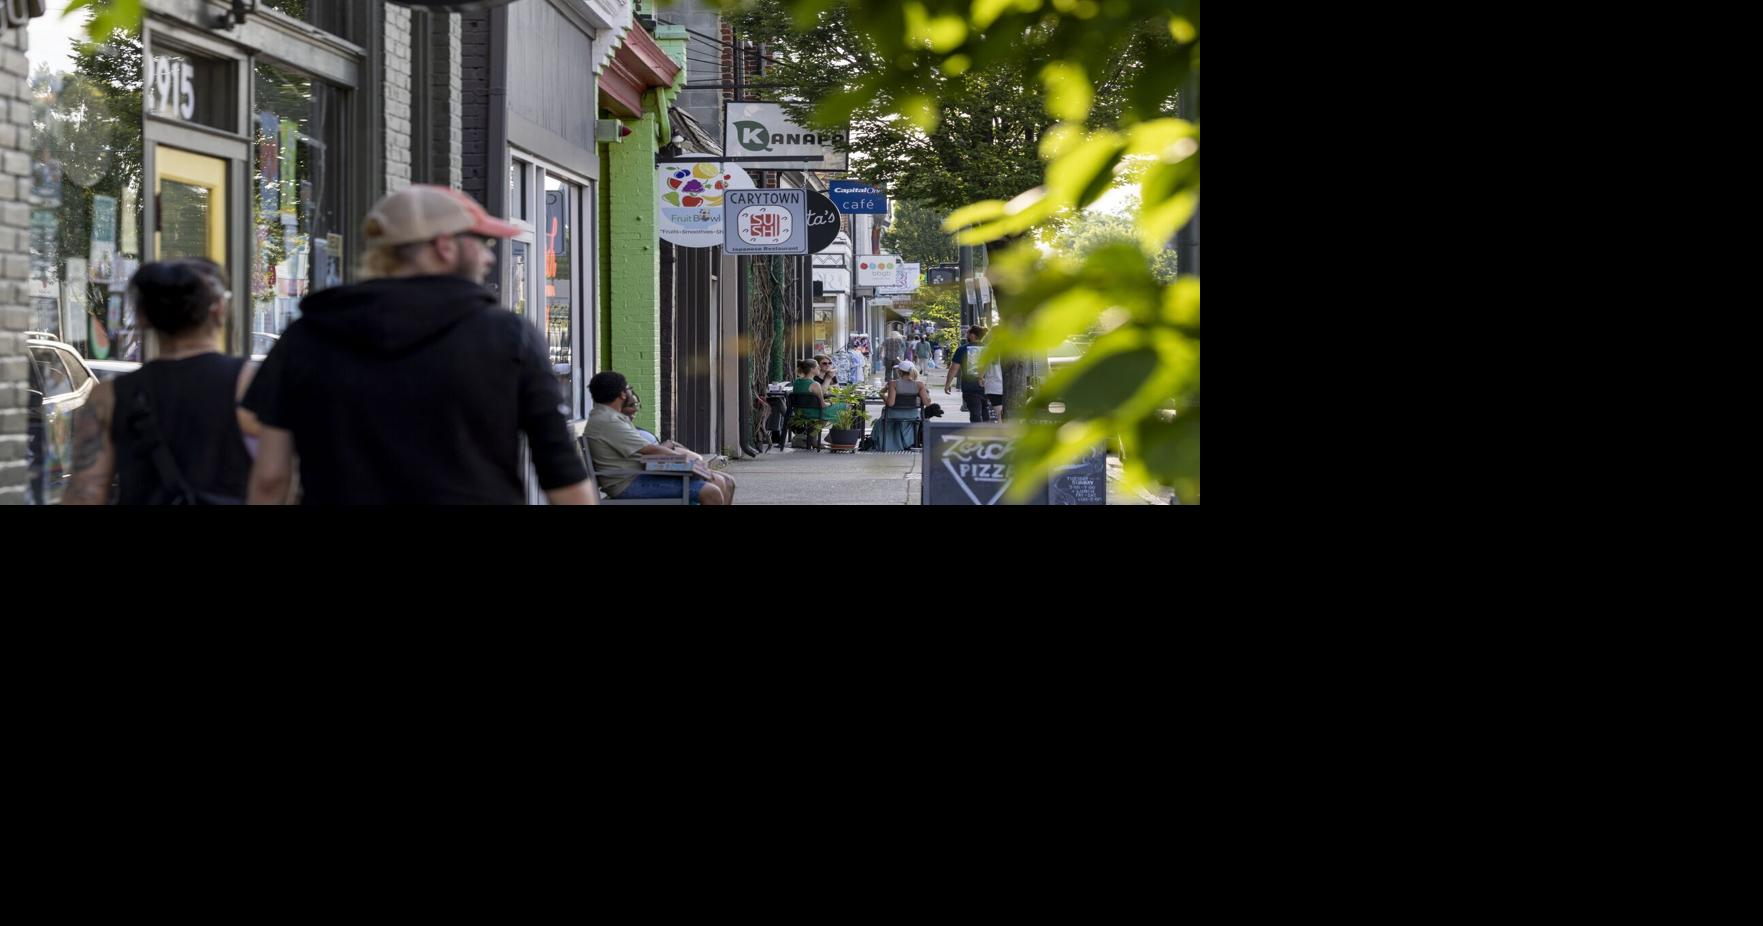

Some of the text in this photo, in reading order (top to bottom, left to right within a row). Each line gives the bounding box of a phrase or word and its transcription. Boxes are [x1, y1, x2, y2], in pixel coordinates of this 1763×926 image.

[730, 193, 799, 204] CARYTOWN
[843, 199, 874, 210] café
[671, 214, 691, 222] Fruit
[807, 210, 835, 226] ta's
